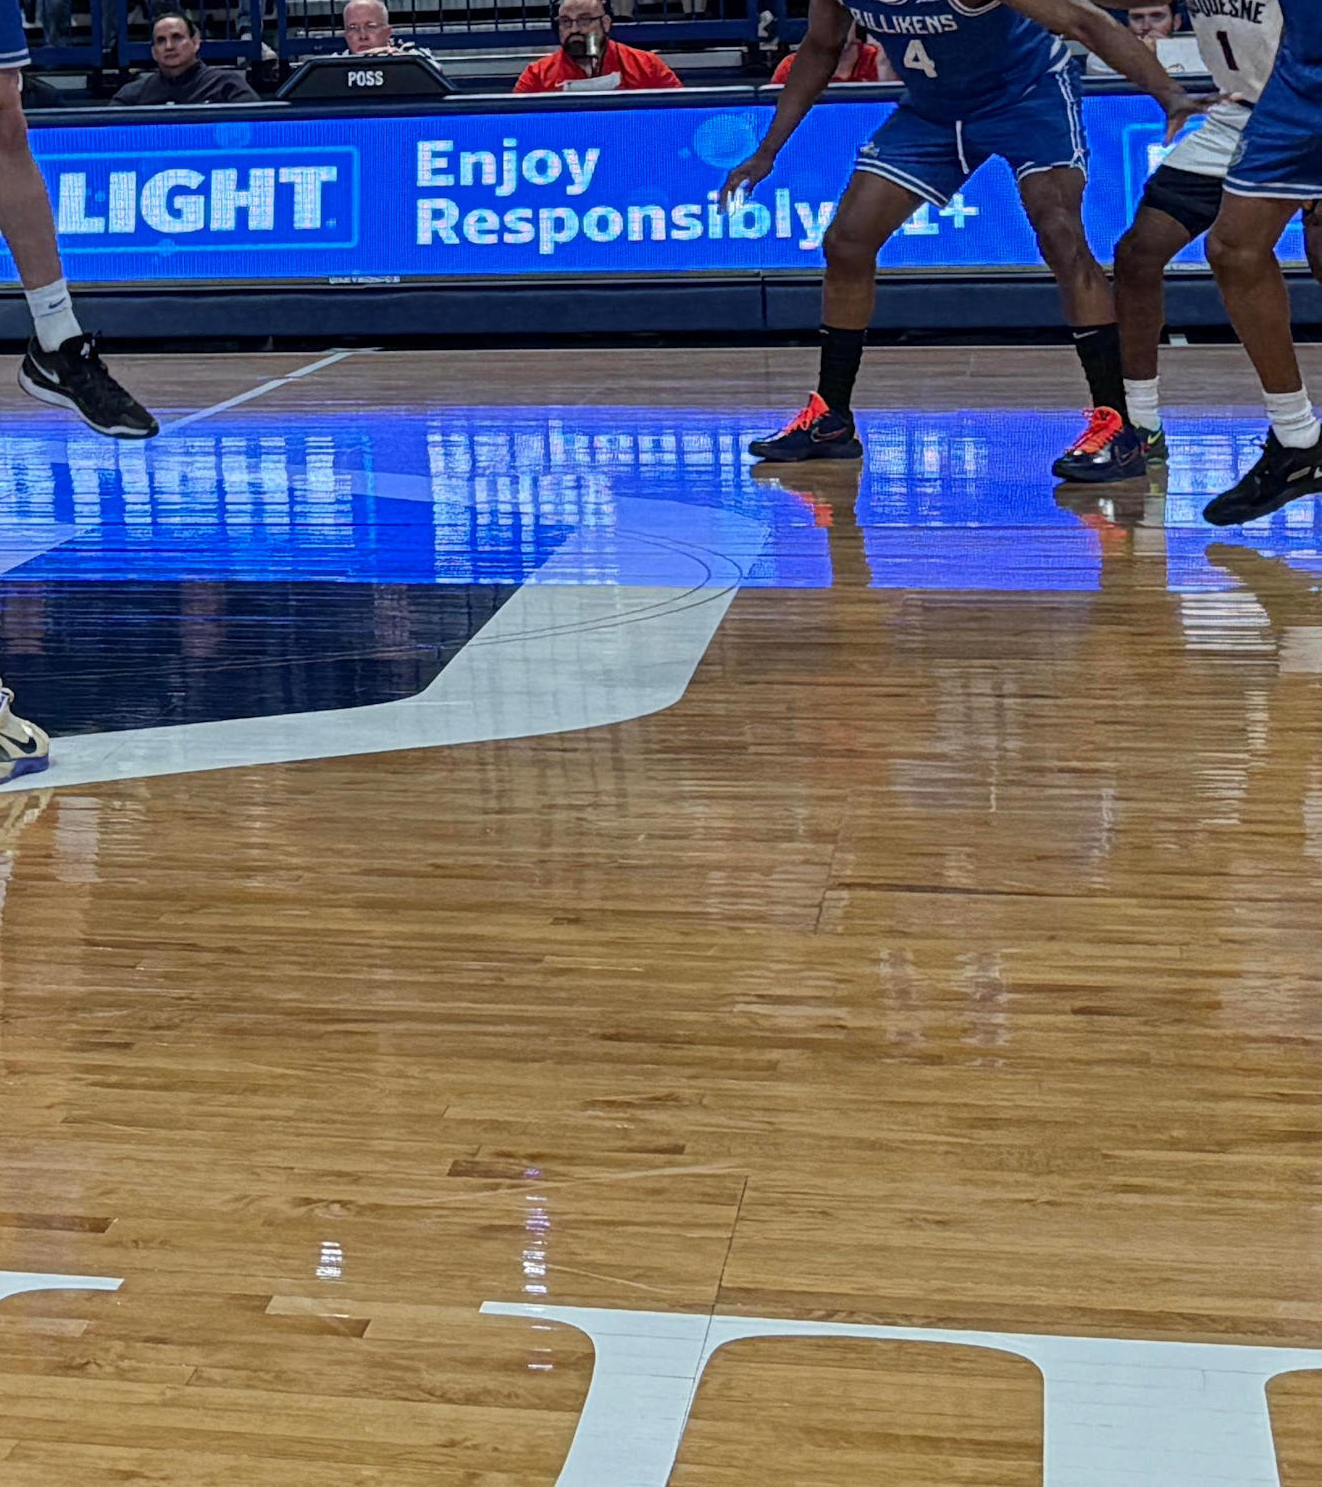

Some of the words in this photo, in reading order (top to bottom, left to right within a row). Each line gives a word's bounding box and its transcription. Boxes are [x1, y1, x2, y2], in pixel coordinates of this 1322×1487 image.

[903, 39, 938, 79] 4
[1216, 31, 1239, 70] 1
[347, 70, 384, 87] POSS
[416, 138, 601, 197] Enjoy
[58, 165, 338, 235] LIGHT
[416, 187, 834, 254] Responsibly
[892, 193, 979, 236] 1+
